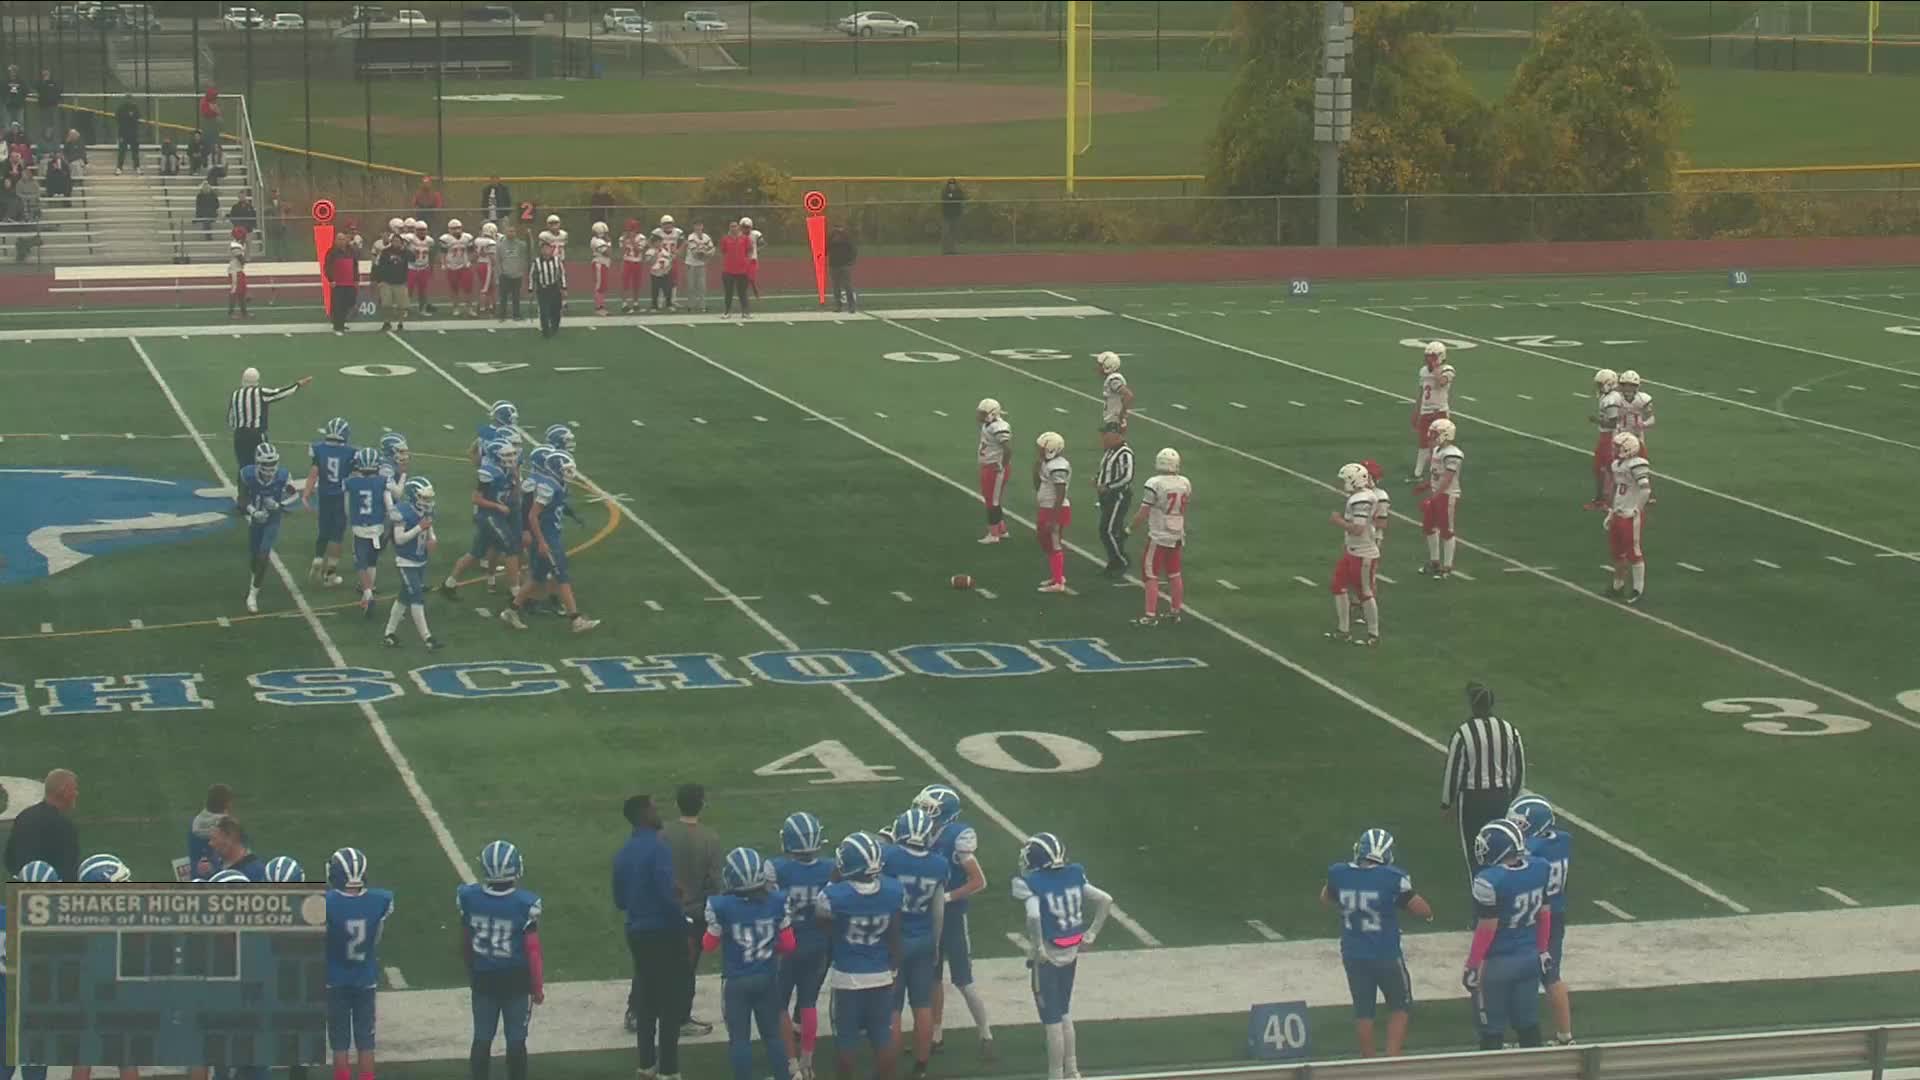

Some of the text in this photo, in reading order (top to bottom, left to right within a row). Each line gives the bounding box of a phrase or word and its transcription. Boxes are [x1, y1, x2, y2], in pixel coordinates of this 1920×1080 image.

[520, 203, 533, 219] 2
[1292, 281, 1309, 294] 20
[1735, 272, 1747, 284] 10
[358, 302, 376, 315] 40
[327, 457, 340, 483] 9
[359, 490, 373, 515] 3
[246, 636, 1208, 706] SCHOOL
[58, 896, 292, 913] SHAKER HIGH SCHOOL
[1339, 889, 1382, 931] 75
[346, 919, 367, 961] 2
[732, 918, 775, 962] 42
[1263, 1013, 1306, 1050] 40
